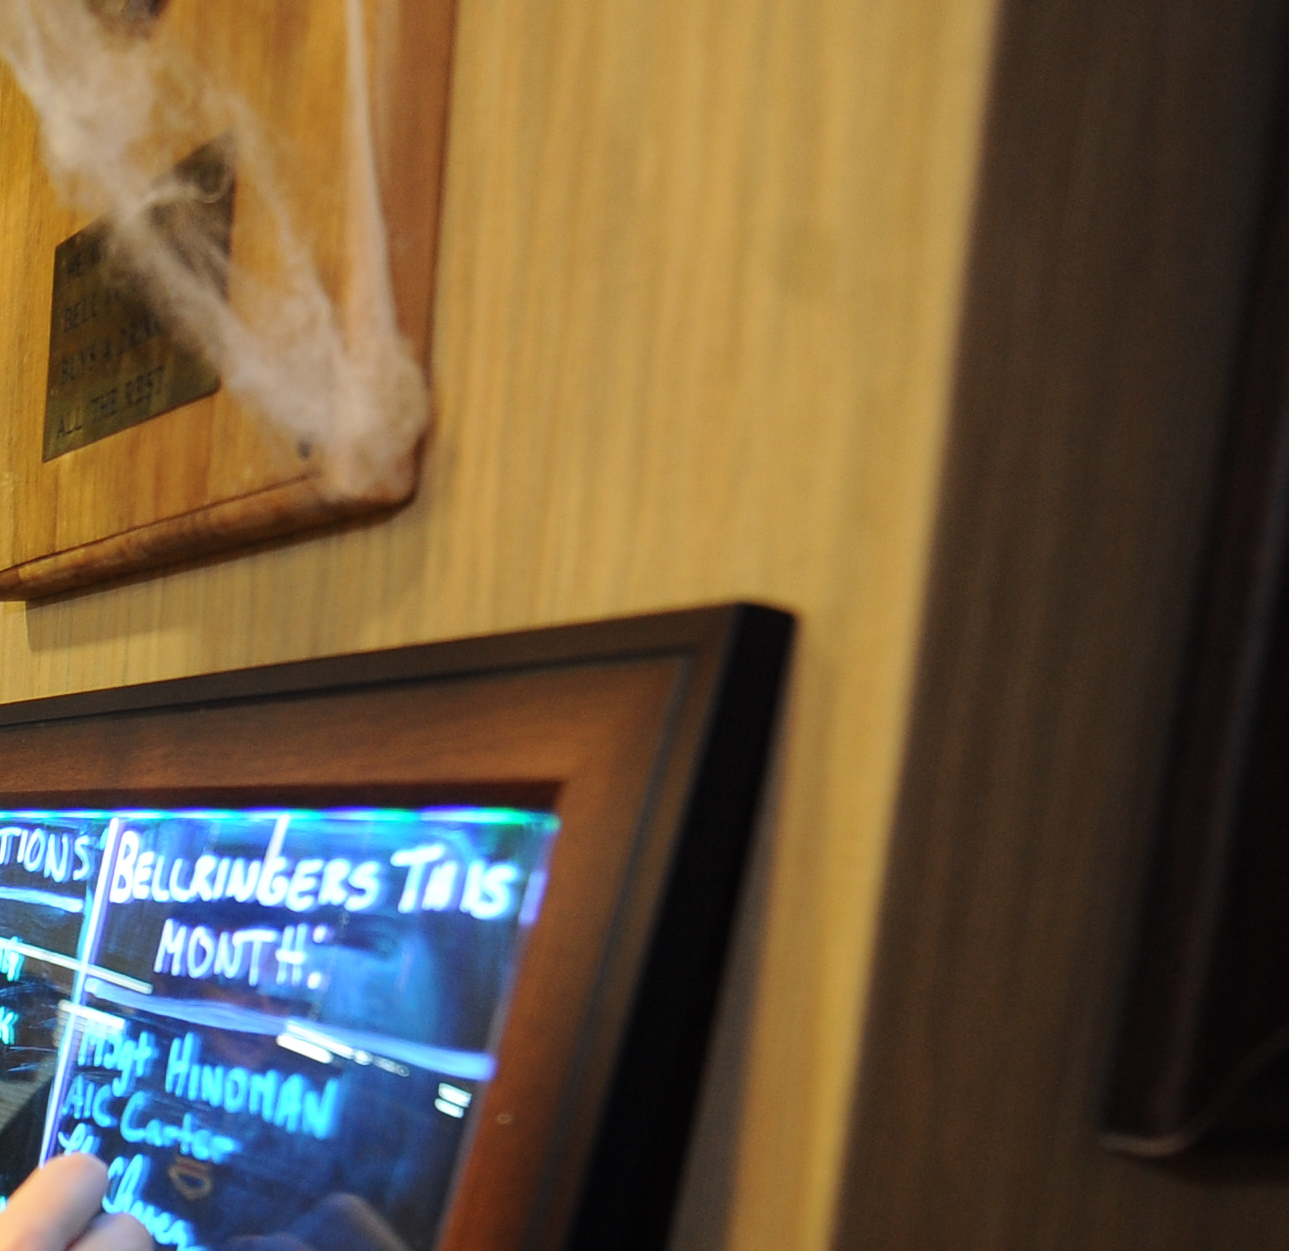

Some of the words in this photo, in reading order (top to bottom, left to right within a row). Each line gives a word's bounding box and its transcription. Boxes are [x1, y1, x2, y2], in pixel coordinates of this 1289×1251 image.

[109, 835, 384, 912] BELLRINGERS
[391, 844, 522, 920] THIS
[154, 918, 329, 987] MONTH:
